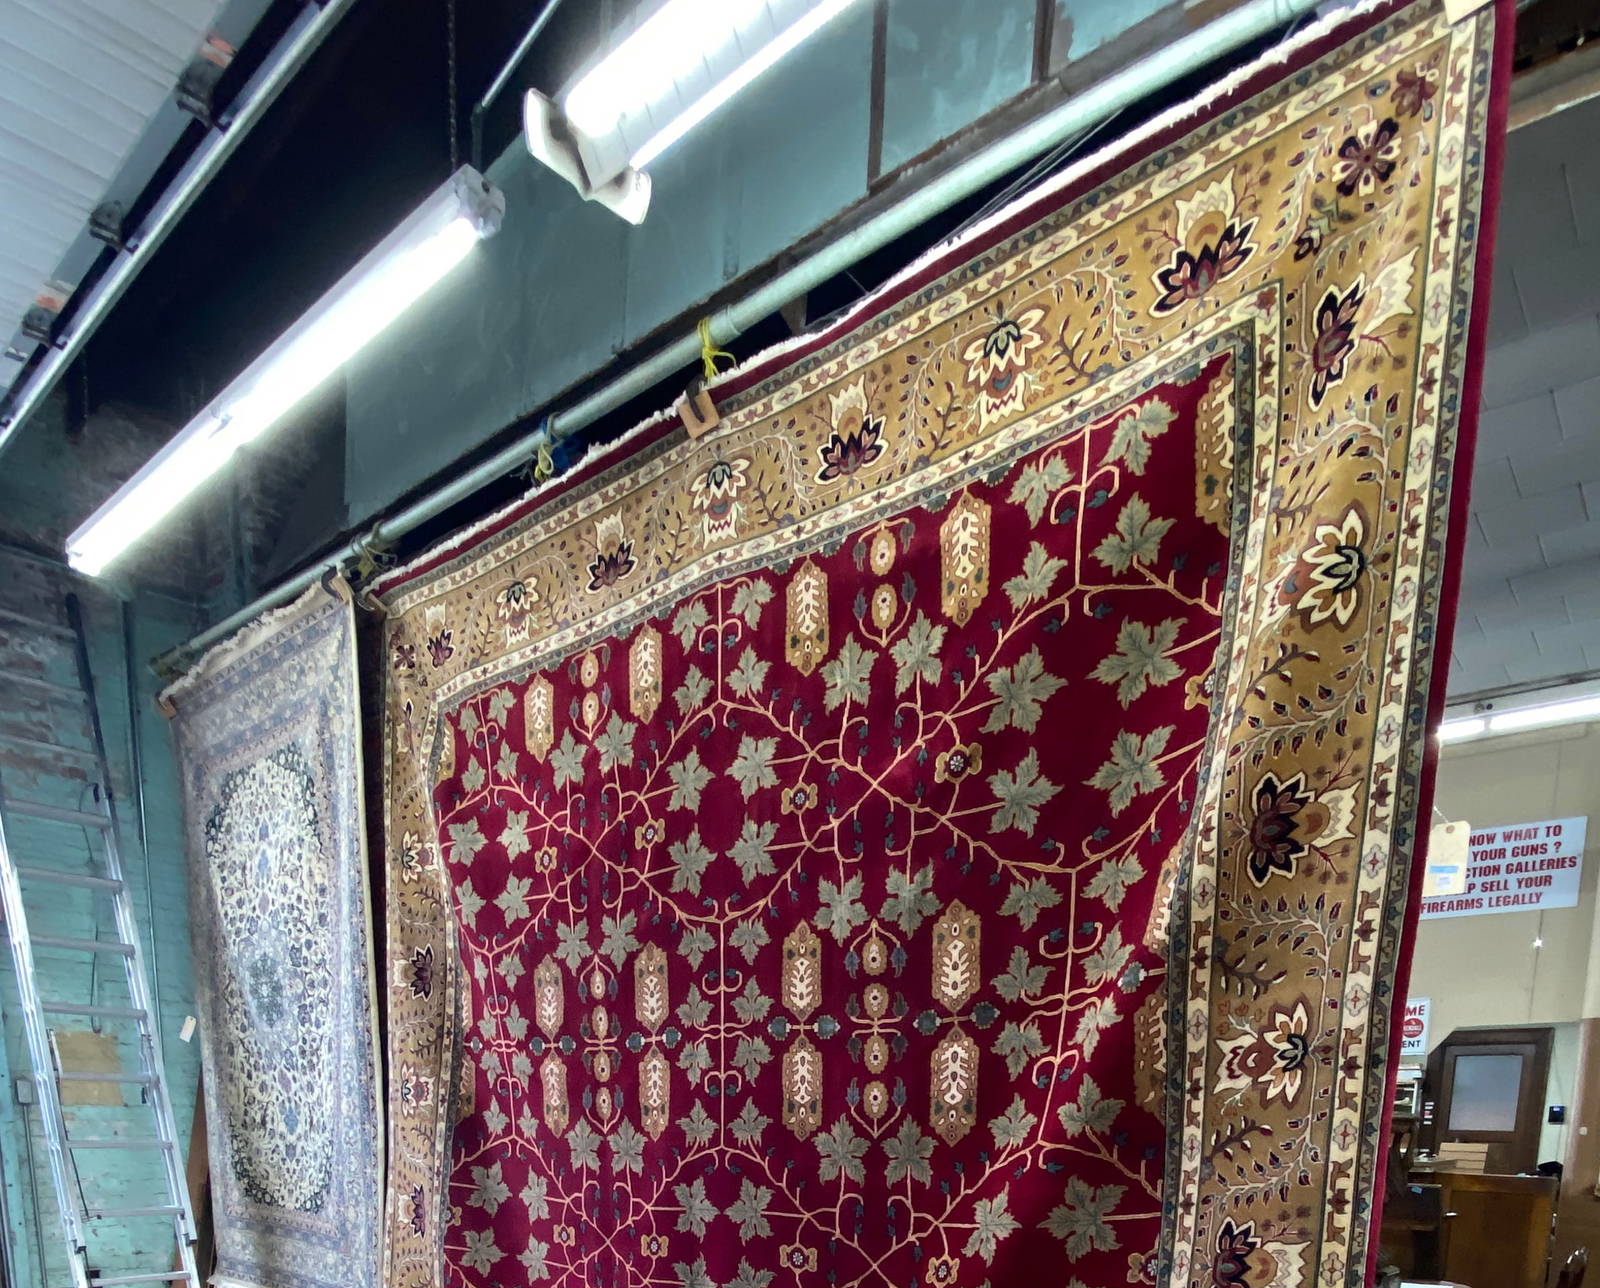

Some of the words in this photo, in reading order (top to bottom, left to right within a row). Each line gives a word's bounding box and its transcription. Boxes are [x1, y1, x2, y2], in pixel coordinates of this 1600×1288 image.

[1503, 827, 1539, 842] WHAT
[1545, 825, 1562, 837] TO
[1472, 848, 1506, 862] YOUR
[1511, 843, 1548, 858] GUNS
[1554, 841, 1562, 853] ?
[1505, 856, 1577, 875] GALLERIES
[1481, 879, 1510, 893] SELL
[1517, 875, 1553, 889] YOUR
[1420, 897, 1483, 914] FIREARMS
[1488, 892, 1544, 908] LEGALLY
